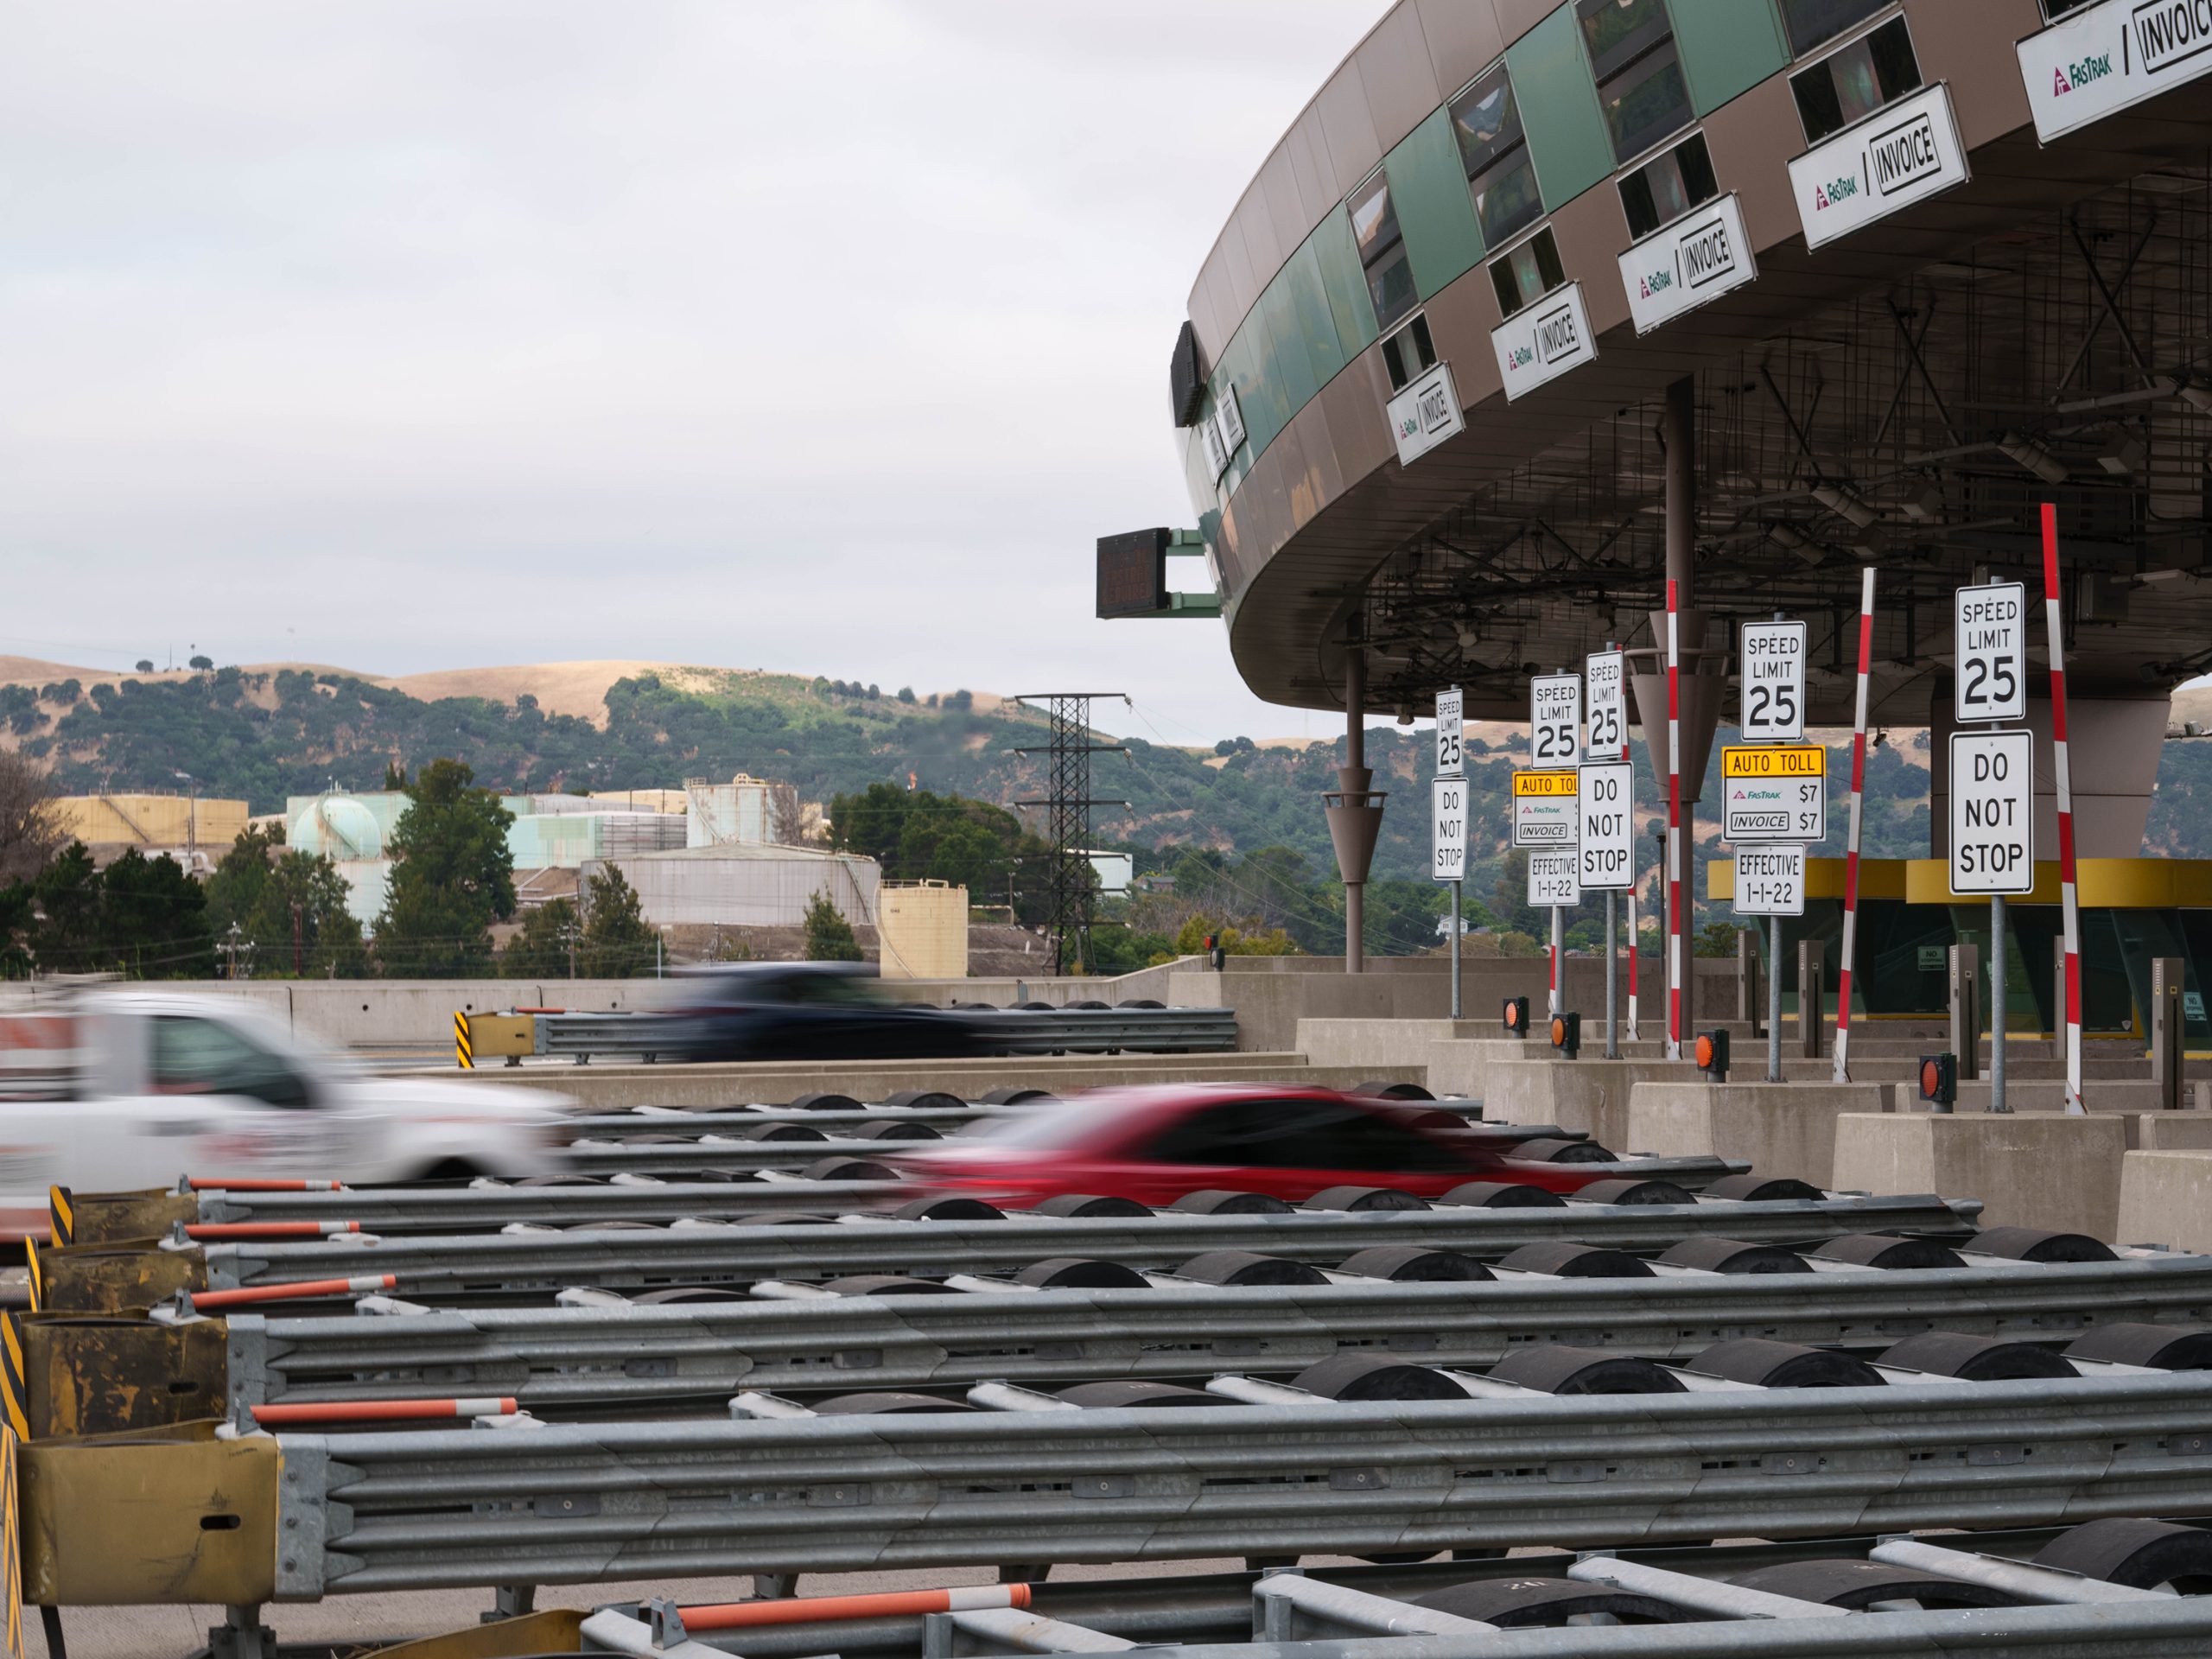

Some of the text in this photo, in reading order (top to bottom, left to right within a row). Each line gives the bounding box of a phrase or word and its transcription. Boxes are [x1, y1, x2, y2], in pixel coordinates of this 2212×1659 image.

[2141, 0, 2212, 60] INVOIC
[1876, 125, 1934, 184] INVOICE
[1685, 229, 1729, 278] INVOICE
[1541, 314, 1575, 355] INVOICE
[1962, 601, 2017, 624] SPEED
[1748, 637, 1799, 655] SPEED
[1968, 629, 2011, 650] LIMIT
[1590, 664, 1619, 683] SPEED
[1752, 661, 1793, 678] LIMIT
[1964, 656, 2016, 705] 25
[1536, 687, 1576, 702] SPEED
[1593, 687, 1615, 703] LIMIT
[1439, 700, 1460, 715] SPEED
[1541, 706, 1572, 721] LIMIT
[1749, 685, 1796, 727] 25
[1440, 718, 1458, 732] LIMIT
[1592, 708, 1618, 746] 25
[1440, 735, 1460, 766] 25
[1537, 724, 1575, 758] 25
[1732, 754, 1815, 772] AUTO TOLL
[1974, 753, 2008, 782] DO
[1522, 778, 1577, 792] AUTO TOL
[1594, 779, 1617, 801] DO
[1799, 785, 1817, 803] $7
[1443, 791, 1459, 810] DO
[1733, 812, 1818, 830] INVOICE $7
[1966, 798, 2016, 827] NOT
[1440, 821, 1462, 838] NOT
[1522, 826, 1565, 836] INVOICE
[1588, 814, 1623, 836] NOT
[1438, 849, 1462, 867] STOP
[1533, 858, 1577, 875] EFFECTIVE
[1585, 849, 1627, 873] STOP
[1739, 855, 1800, 876] EFFECTIVE
[1960, 843, 2023, 873] STOP
[1538, 880, 1572, 897] 1-1-22
[1747, 882, 1792, 904] 1-1-22
